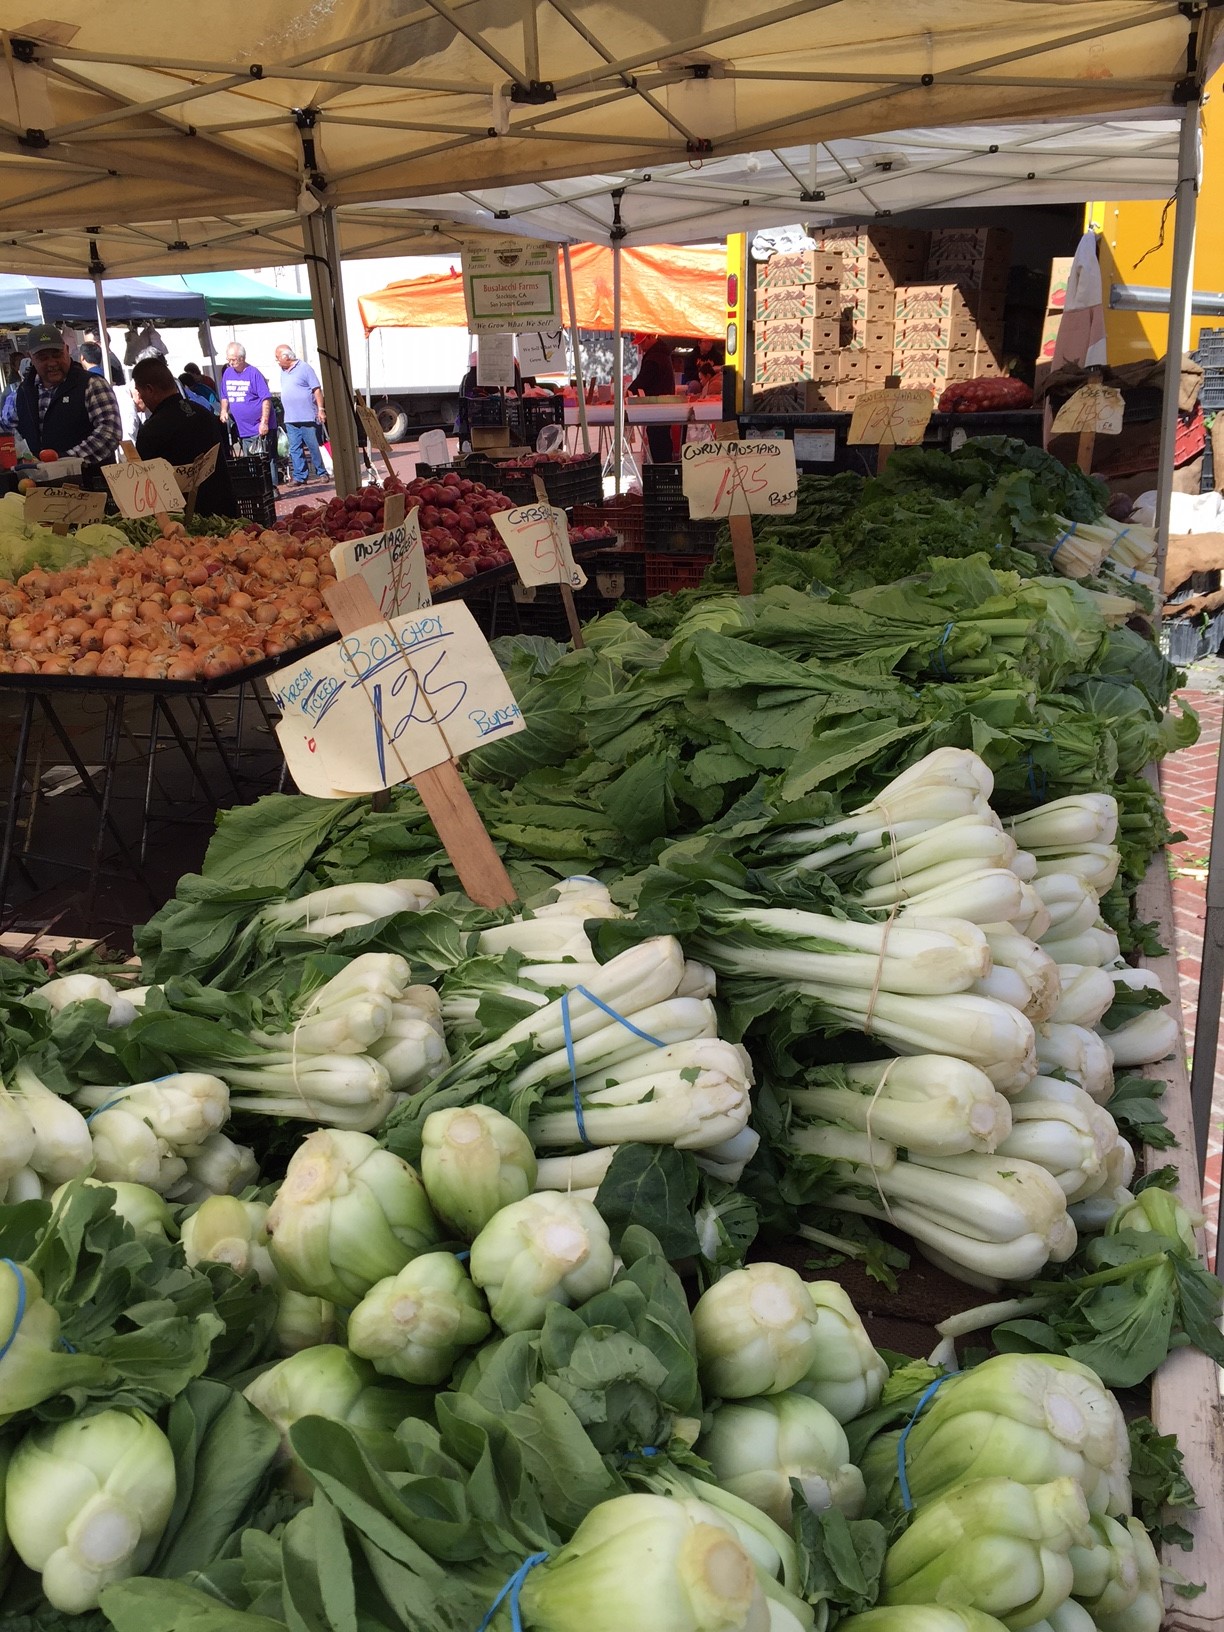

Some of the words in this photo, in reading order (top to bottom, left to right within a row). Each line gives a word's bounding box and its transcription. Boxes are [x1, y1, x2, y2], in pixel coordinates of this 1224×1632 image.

[467, 246, 490, 255] Support
[525, 259, 554, 267] Farmland
[483, 282, 517, 293] Busalacchi
[518, 283, 539, 291] Farms
[487, 321, 504, 329] Grow
[507, 320, 523, 328] What
[683, 443, 723, 461] CURLY
[727, 441, 781, 457] MUSTARD
[134, 478, 157, 513] 60
[281, 667, 314, 705] FRESH
[300, 677, 339, 720] PICKED
